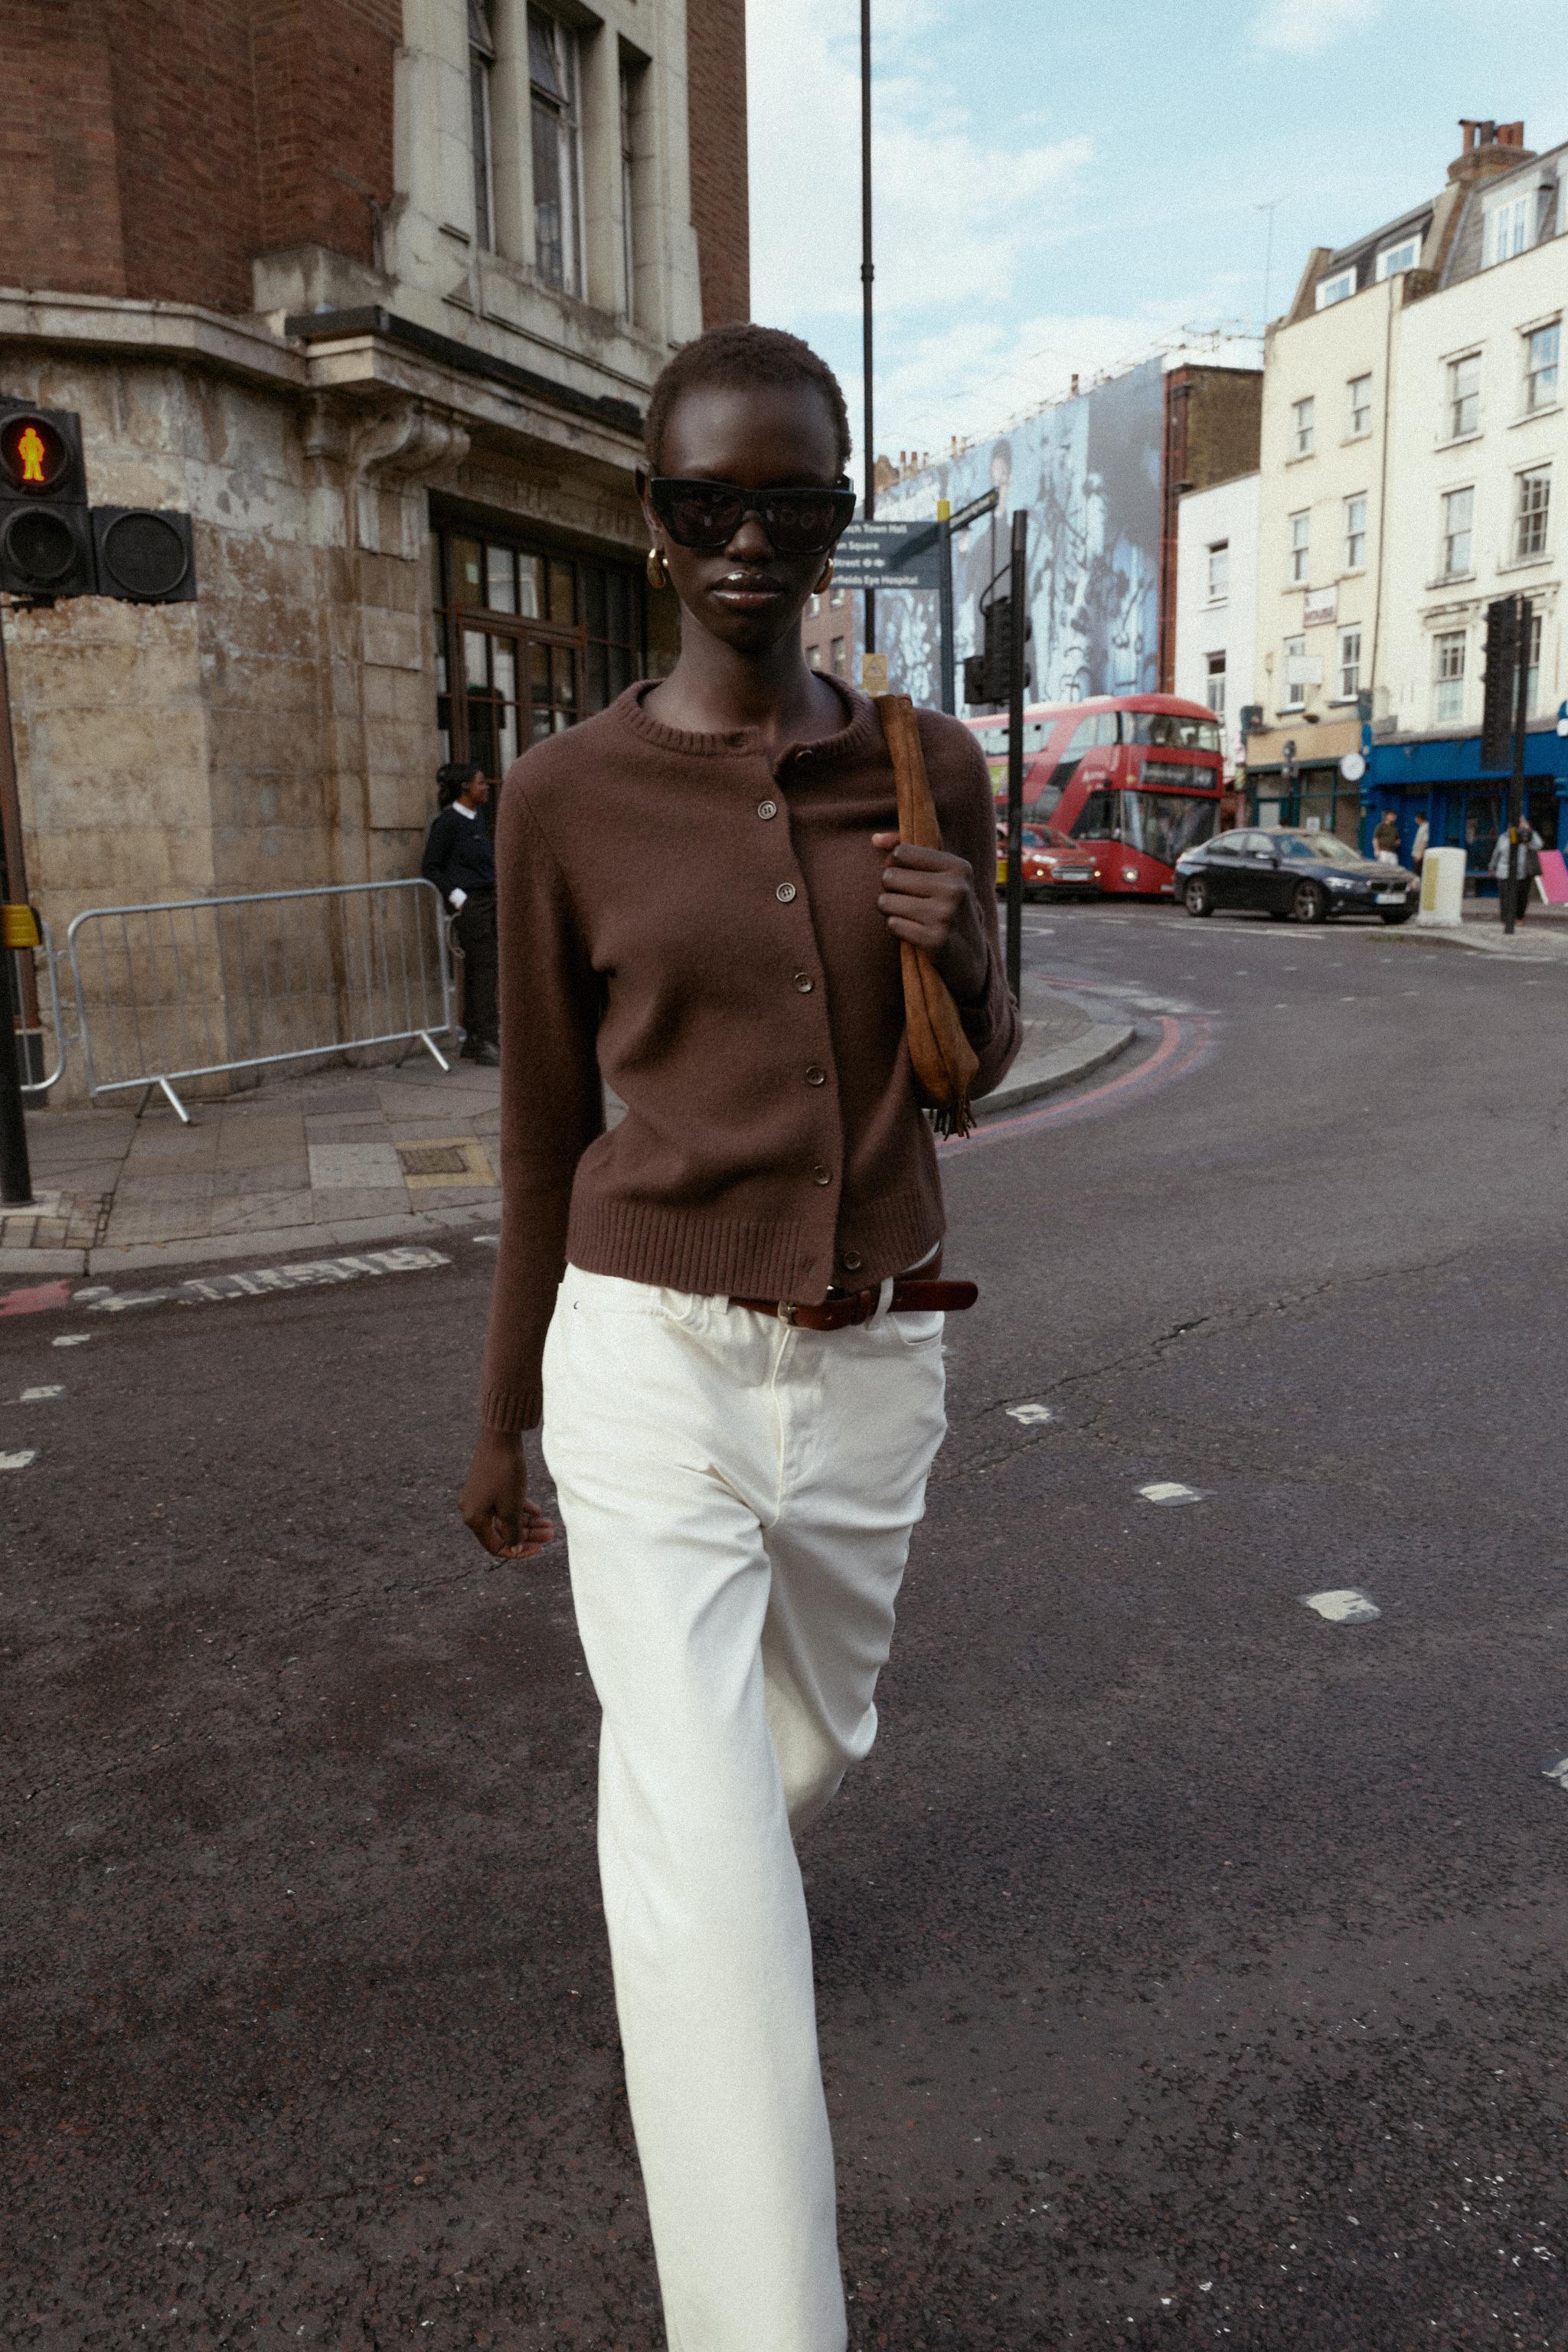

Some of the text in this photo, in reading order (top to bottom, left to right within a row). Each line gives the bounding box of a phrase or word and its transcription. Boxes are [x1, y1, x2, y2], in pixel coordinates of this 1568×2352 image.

[862, 524, 887, 534] Town
[889, 524, 907, 534] Hall
[848, 541, 880, 552] Square
[864, 575, 880, 586] Eye
[880, 575, 919, 586] Hospital
